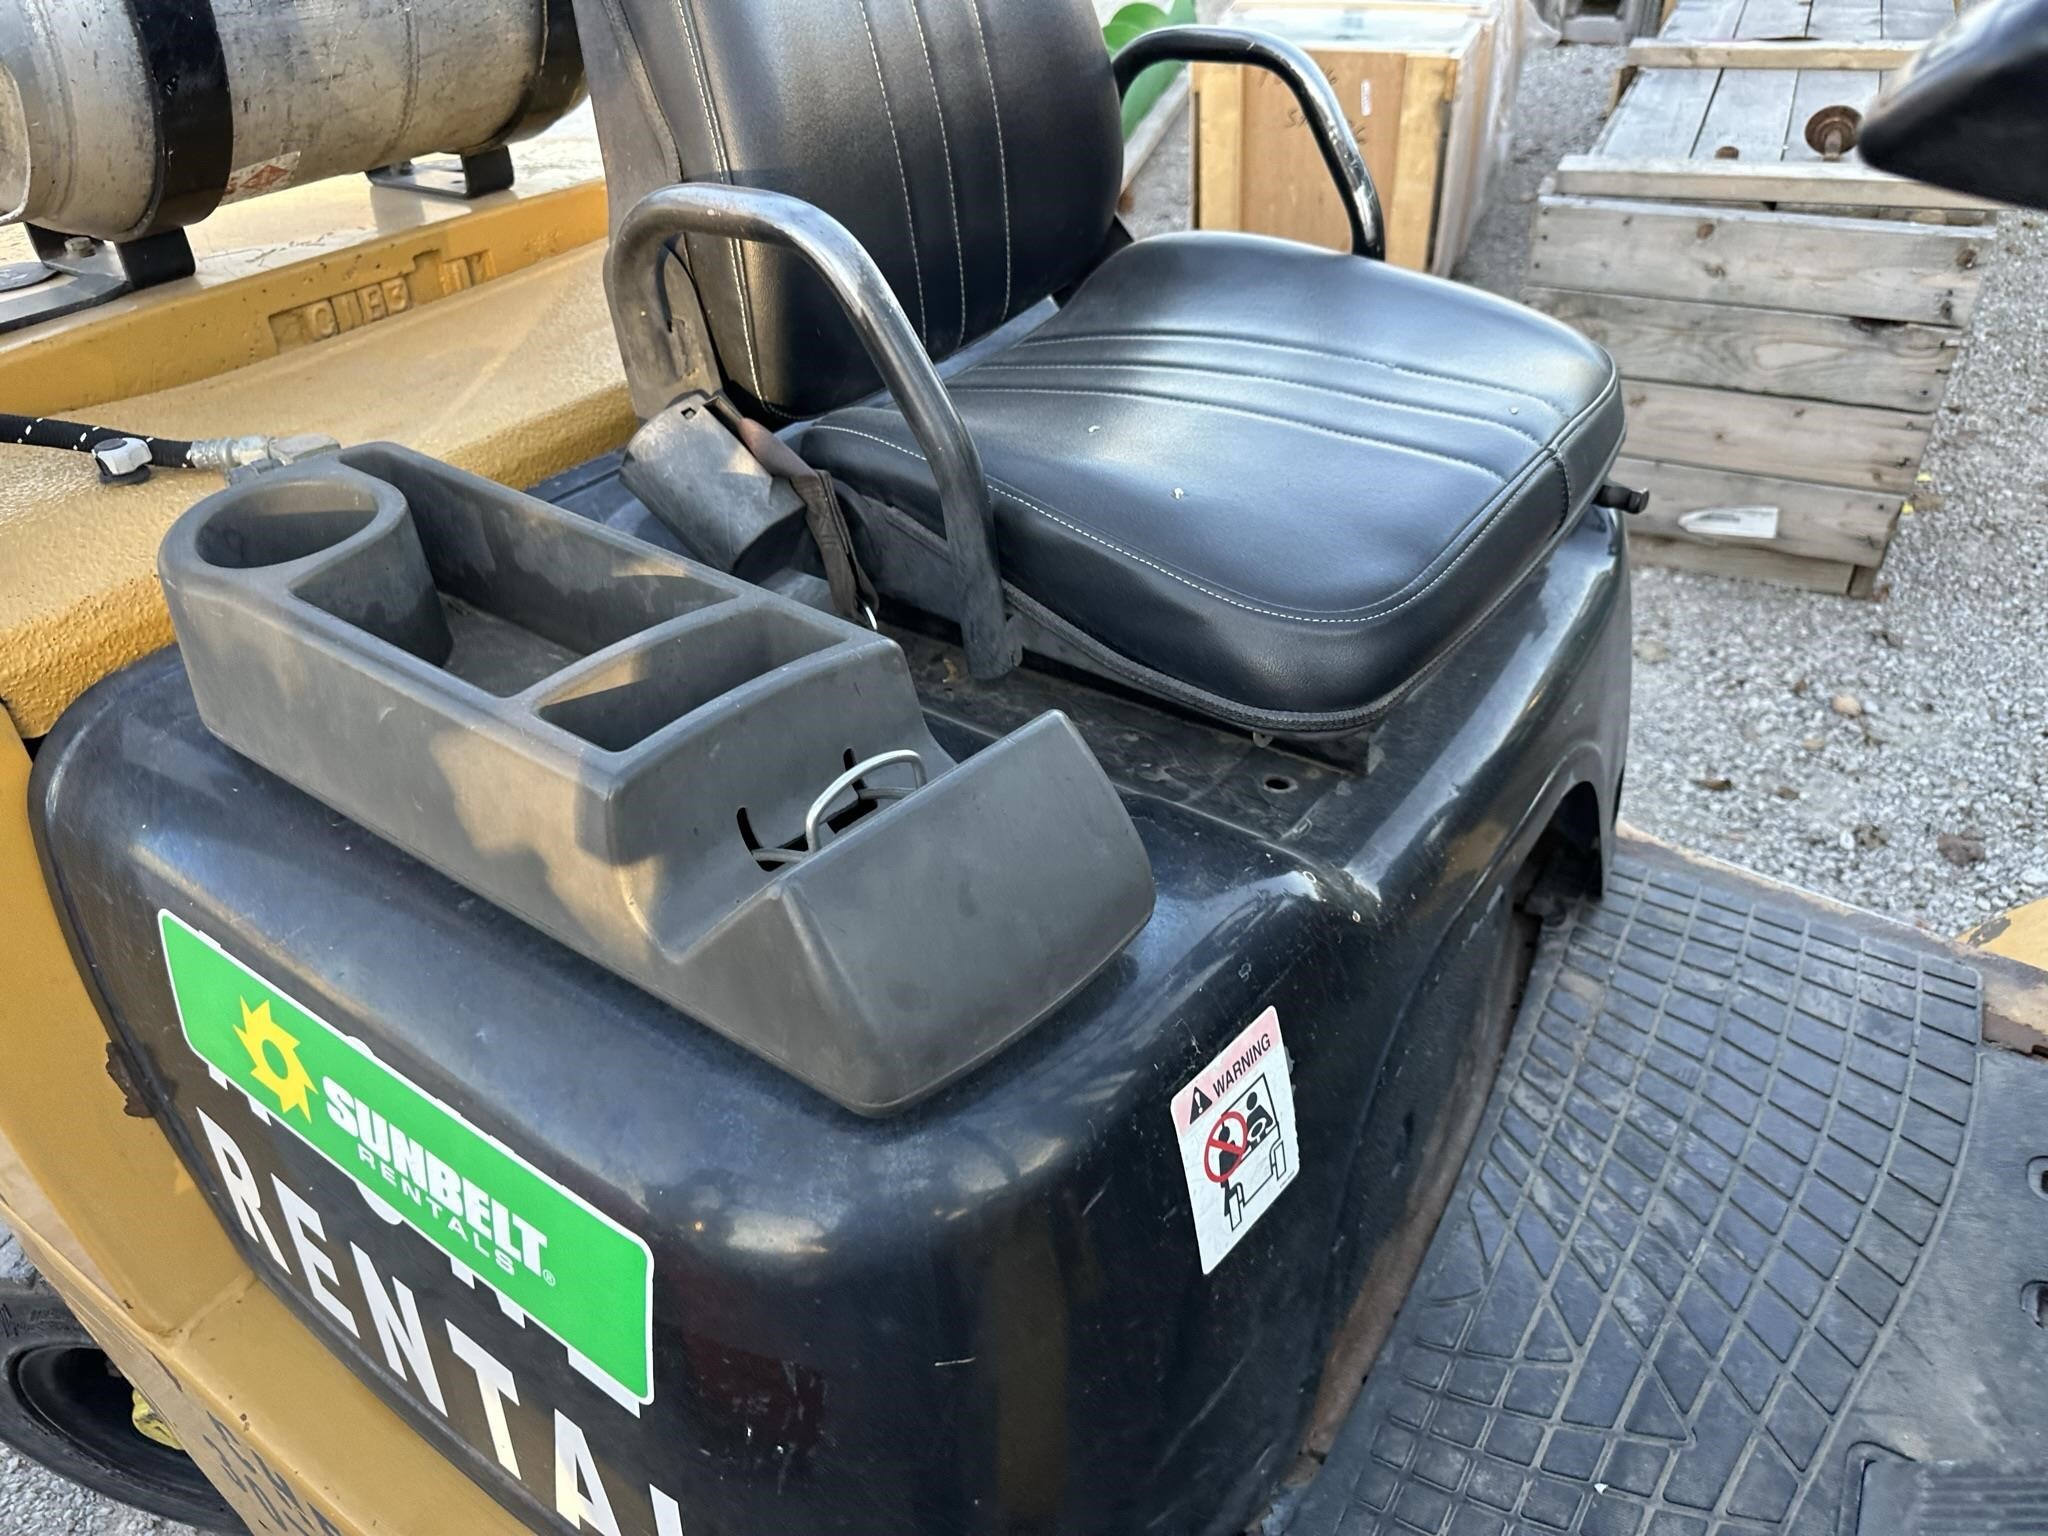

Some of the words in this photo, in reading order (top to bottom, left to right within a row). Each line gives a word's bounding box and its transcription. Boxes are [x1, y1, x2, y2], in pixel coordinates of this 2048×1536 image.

[1212, 1033, 1271, 1098] WARNING
[322, 1075, 548, 1278] SUNBELT
[357, 1143, 515, 1277] RENTALS
